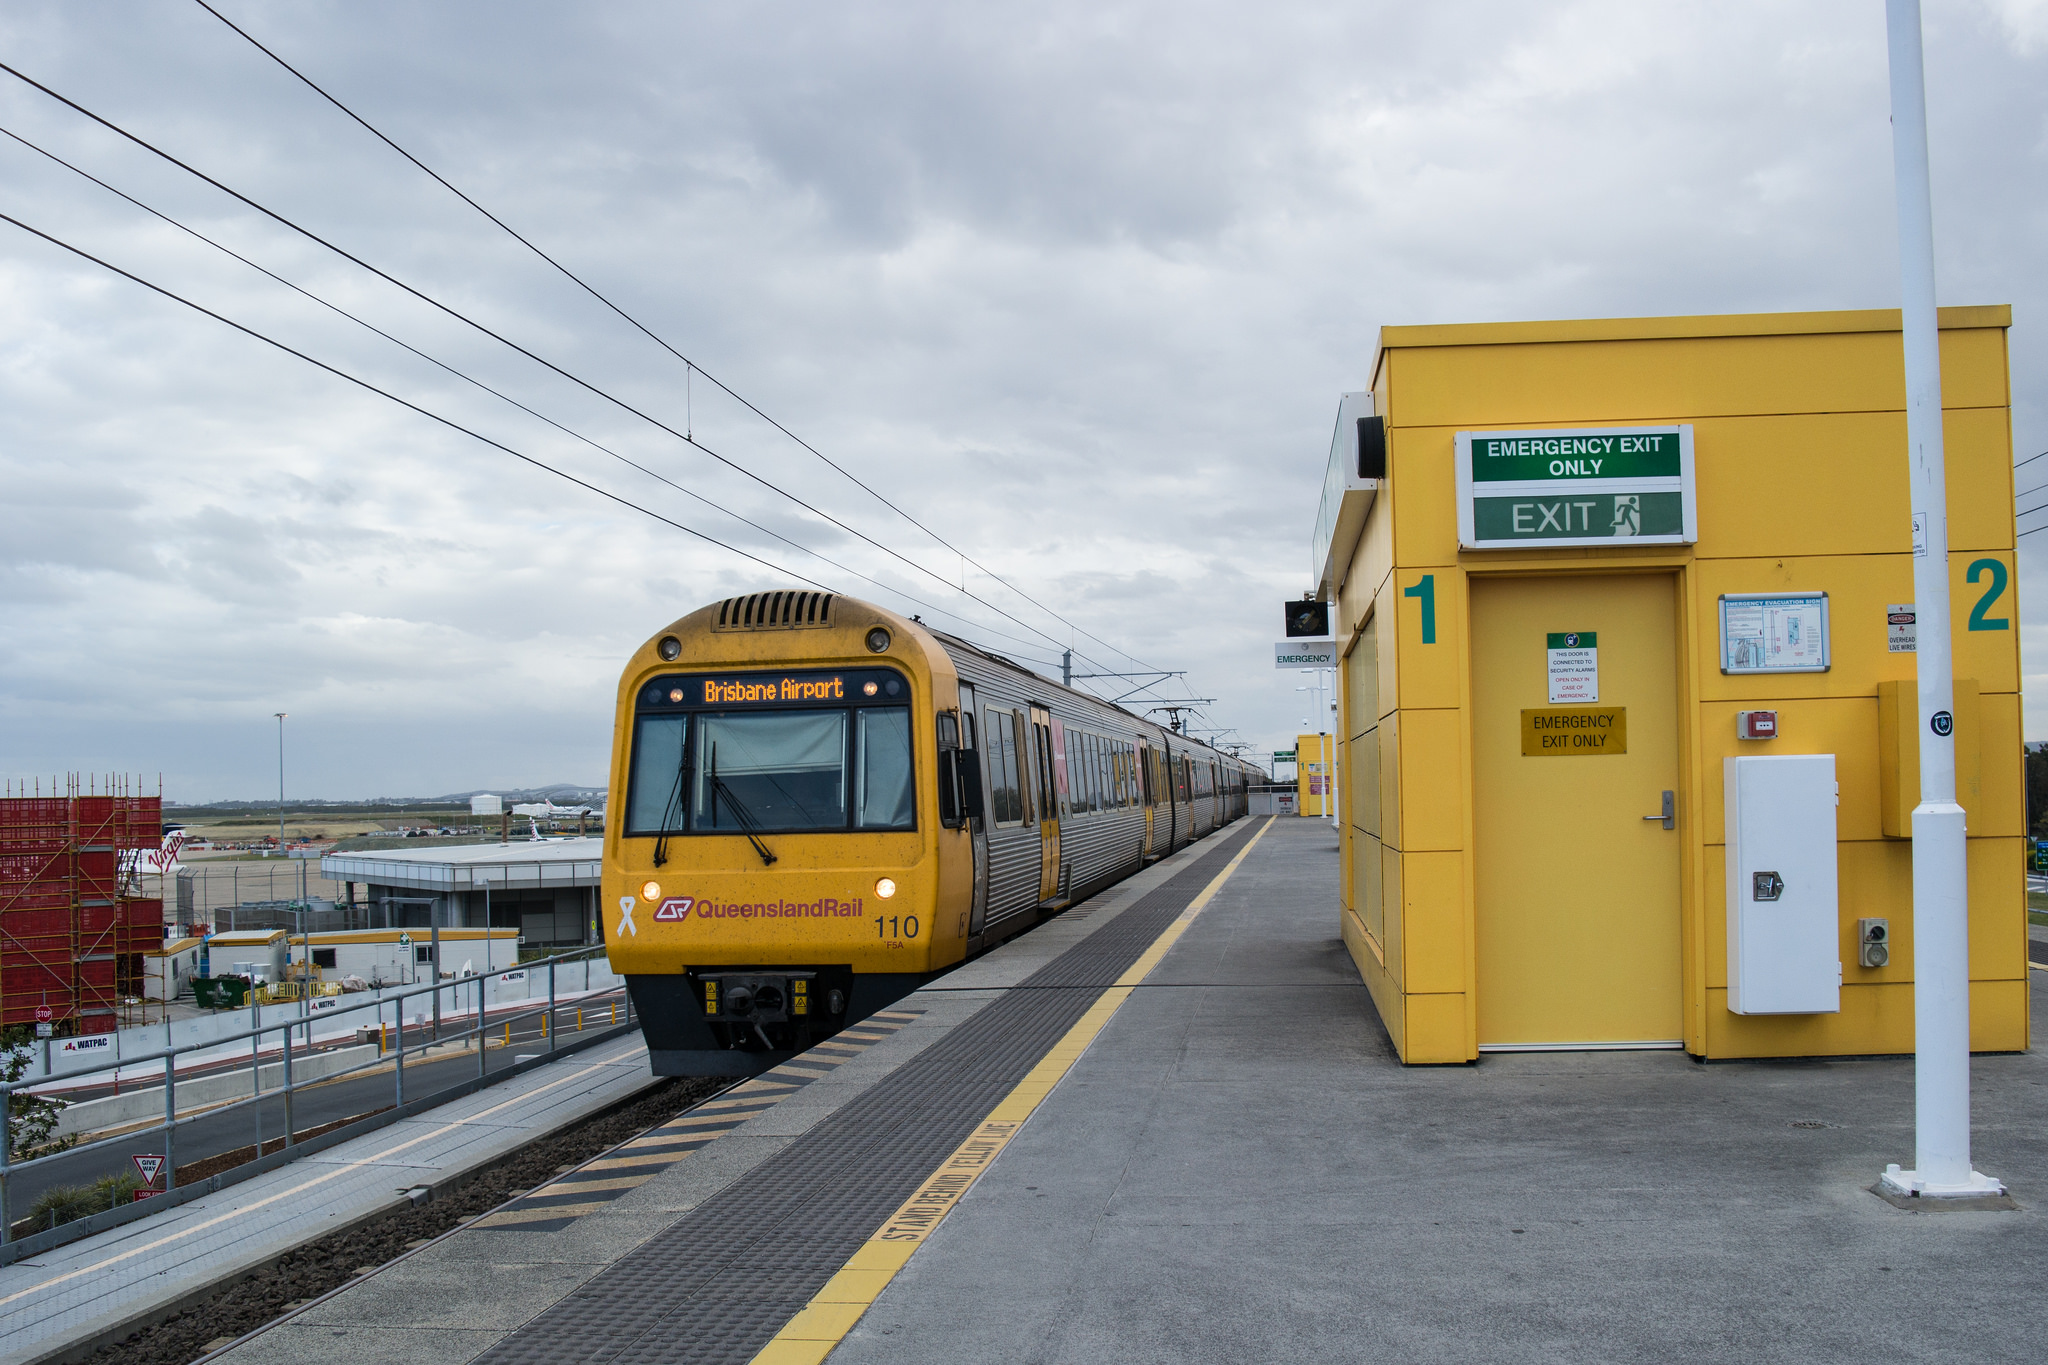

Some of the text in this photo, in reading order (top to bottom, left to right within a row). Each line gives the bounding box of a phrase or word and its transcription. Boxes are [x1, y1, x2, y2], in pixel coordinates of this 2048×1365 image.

[1488, 436, 1663, 457] EMERGENCY EXIT
[1549, 459, 1603, 476] ONLY
[1512, 501, 1597, 533] EXIT
[1966, 558, 2009, 631] 2
[1404, 574, 1436, 644] 1
[1277, 654, 1331, 663] EMERGENCY
[705, 677, 844, 702] Brisbane Airport
[1533, 714, 1615, 729] EMERGENCY
[1542, 734, 1607, 748] EXIT ONLY
[148, 831, 185, 873] Virgin
[874, 915, 919, 938] 110
[508, 971, 524, 980] WATPAC
[37, 1010, 51, 1018] STOP
[318, 1000, 336, 1009] WATPAC
[77, 1038, 108, 1049] WATPAC
[881, 1207, 943, 1241] STAND
[912, 1174, 973, 1205] BEHIND
[947, 1140, 1001, 1169] YELLOW
